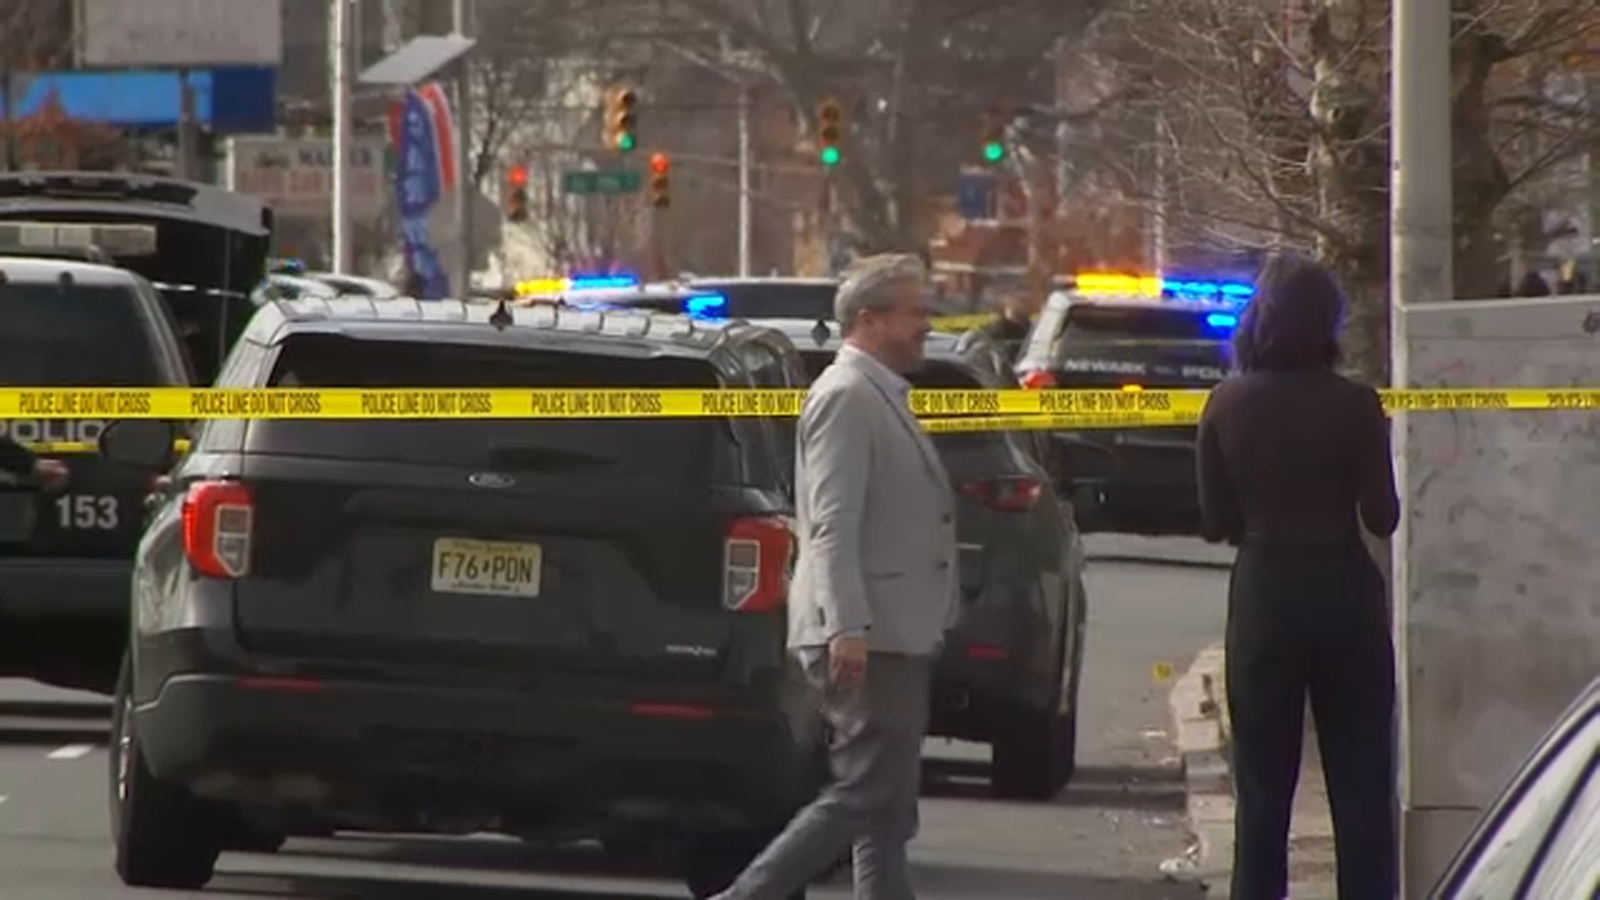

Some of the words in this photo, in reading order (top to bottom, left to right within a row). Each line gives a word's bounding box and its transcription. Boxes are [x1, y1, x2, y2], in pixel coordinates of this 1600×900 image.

[1064, 359, 1146, 376] NEWARK
[20, 391, 53, 414] POLICE
[55, 391, 78, 414] LINE
[80, 391, 94, 414] DO
[97, 391, 115, 414] NOT
[118, 391, 150, 414] CROSS
[191, 391, 225, 414] POLICE
[227, 391, 248, 414] LINE
[250, 391, 265, 414] DO
[267, 391, 286, 414] NOT
[289, 391, 321, 414] CROSS
[361, 391, 395, 414] POLICE
[398, 391, 419, 414] LINE
[421, 391, 435, 414] DO
[438, 391, 456, 414] NOT
[460, 391, 492, 414] CROSS
[531, 391, 565, 414] POLICE
[568, 391, 589, 414] LINE
[592, 391, 605, 414] DO
[608, 391, 626, 414] NOT
[629, 391, 662, 414] CROSS
[701, 391, 735, 413] POLICE
[738, 391, 758, 413] LINE
[761, 391, 775, 413] DO
[777, 391, 796, 413] NOT
[929, 391, 943, 412] DO
[945, 391, 964, 412] NOT
[967, 391, 999, 412] CROSS
[1039, 391, 1074, 411] POLICE
[1076, 391, 1097, 411] LINE
[1099, 391, 1113, 411] DO
[1115, 391, 1136, 411] NOT
[1139, 391, 1171, 411] CROSS
[1475, 391, 1508, 408] CROSS
[1546, 391, 1582, 408] POLICE
[56, 494, 118, 529] 153
